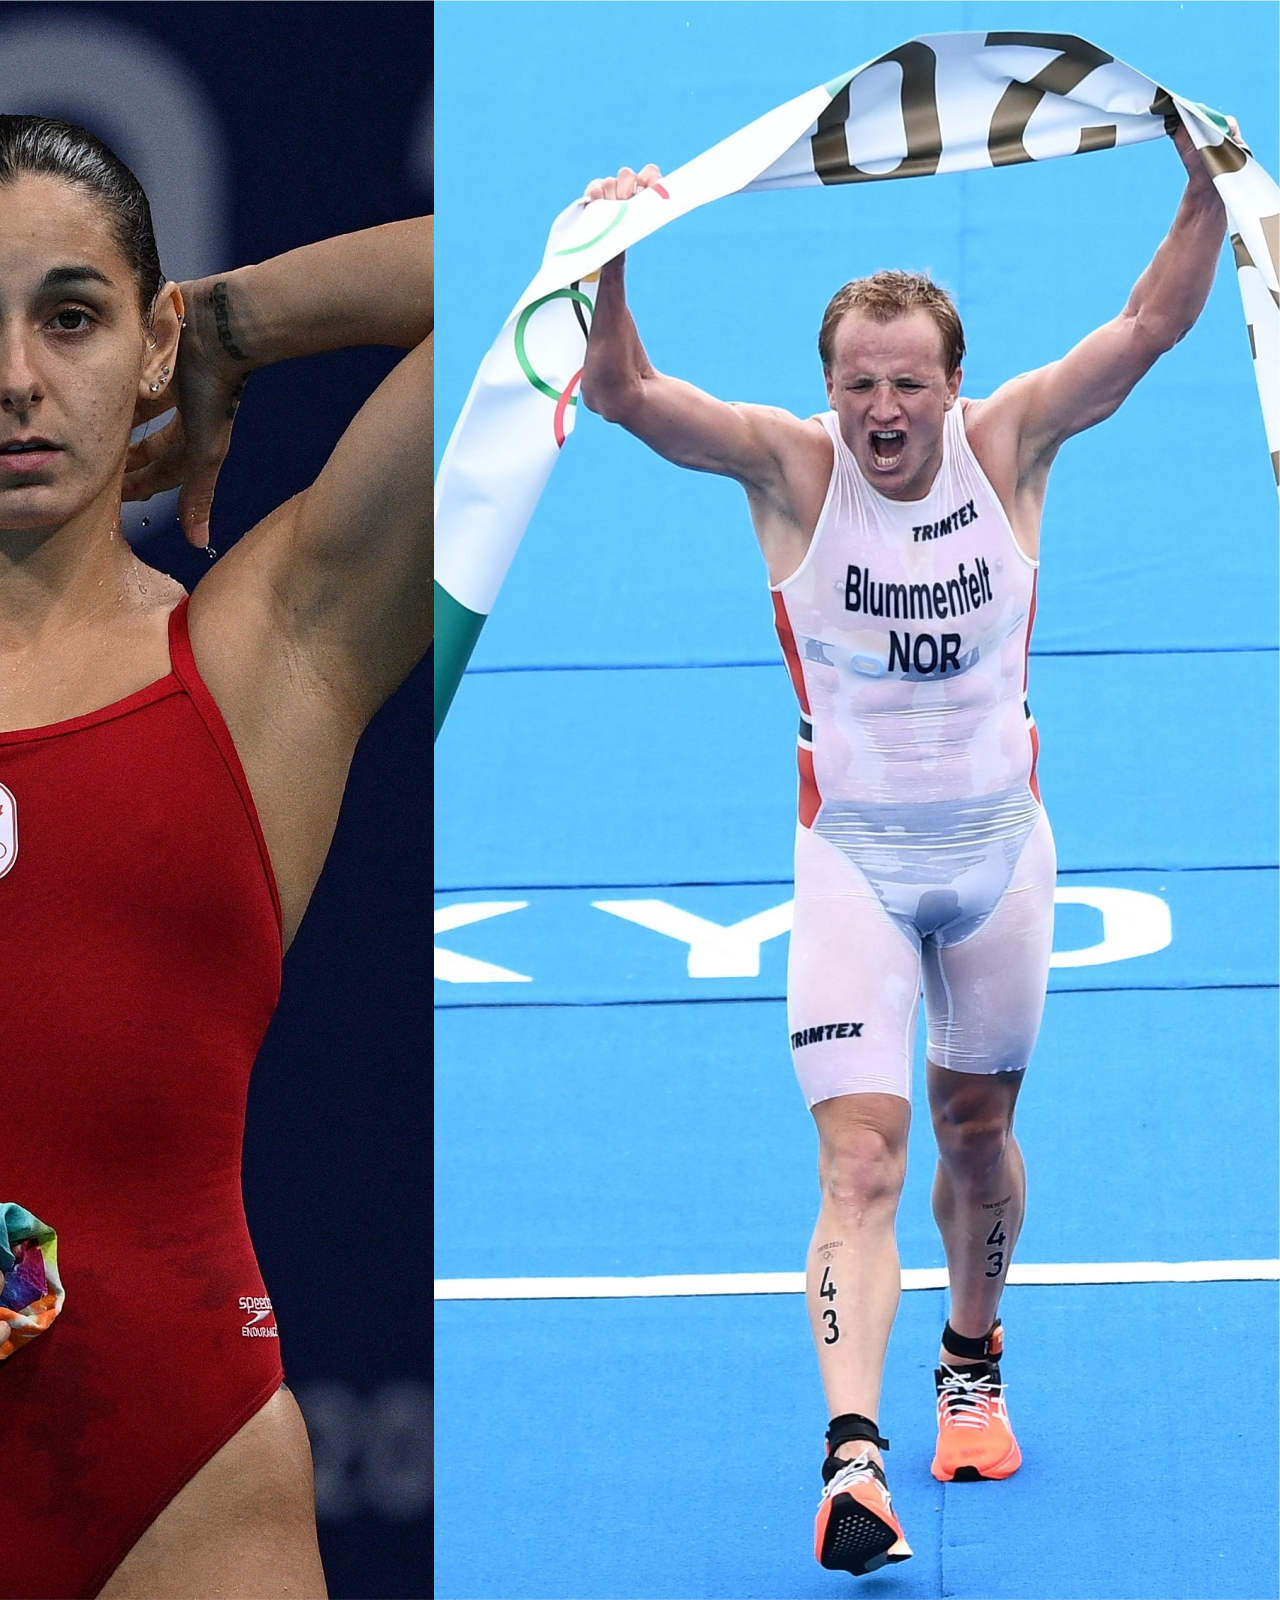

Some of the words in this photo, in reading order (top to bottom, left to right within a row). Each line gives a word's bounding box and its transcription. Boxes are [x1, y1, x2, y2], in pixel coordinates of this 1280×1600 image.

[911, 499, 979, 543] TRIMTEX
[844, 556, 993, 620] Blummenfelt
[888, 630, 962, 674] NOR
[790, 1022, 865, 1051] TRIMTEX
[238, 1293, 273, 1315] speed
